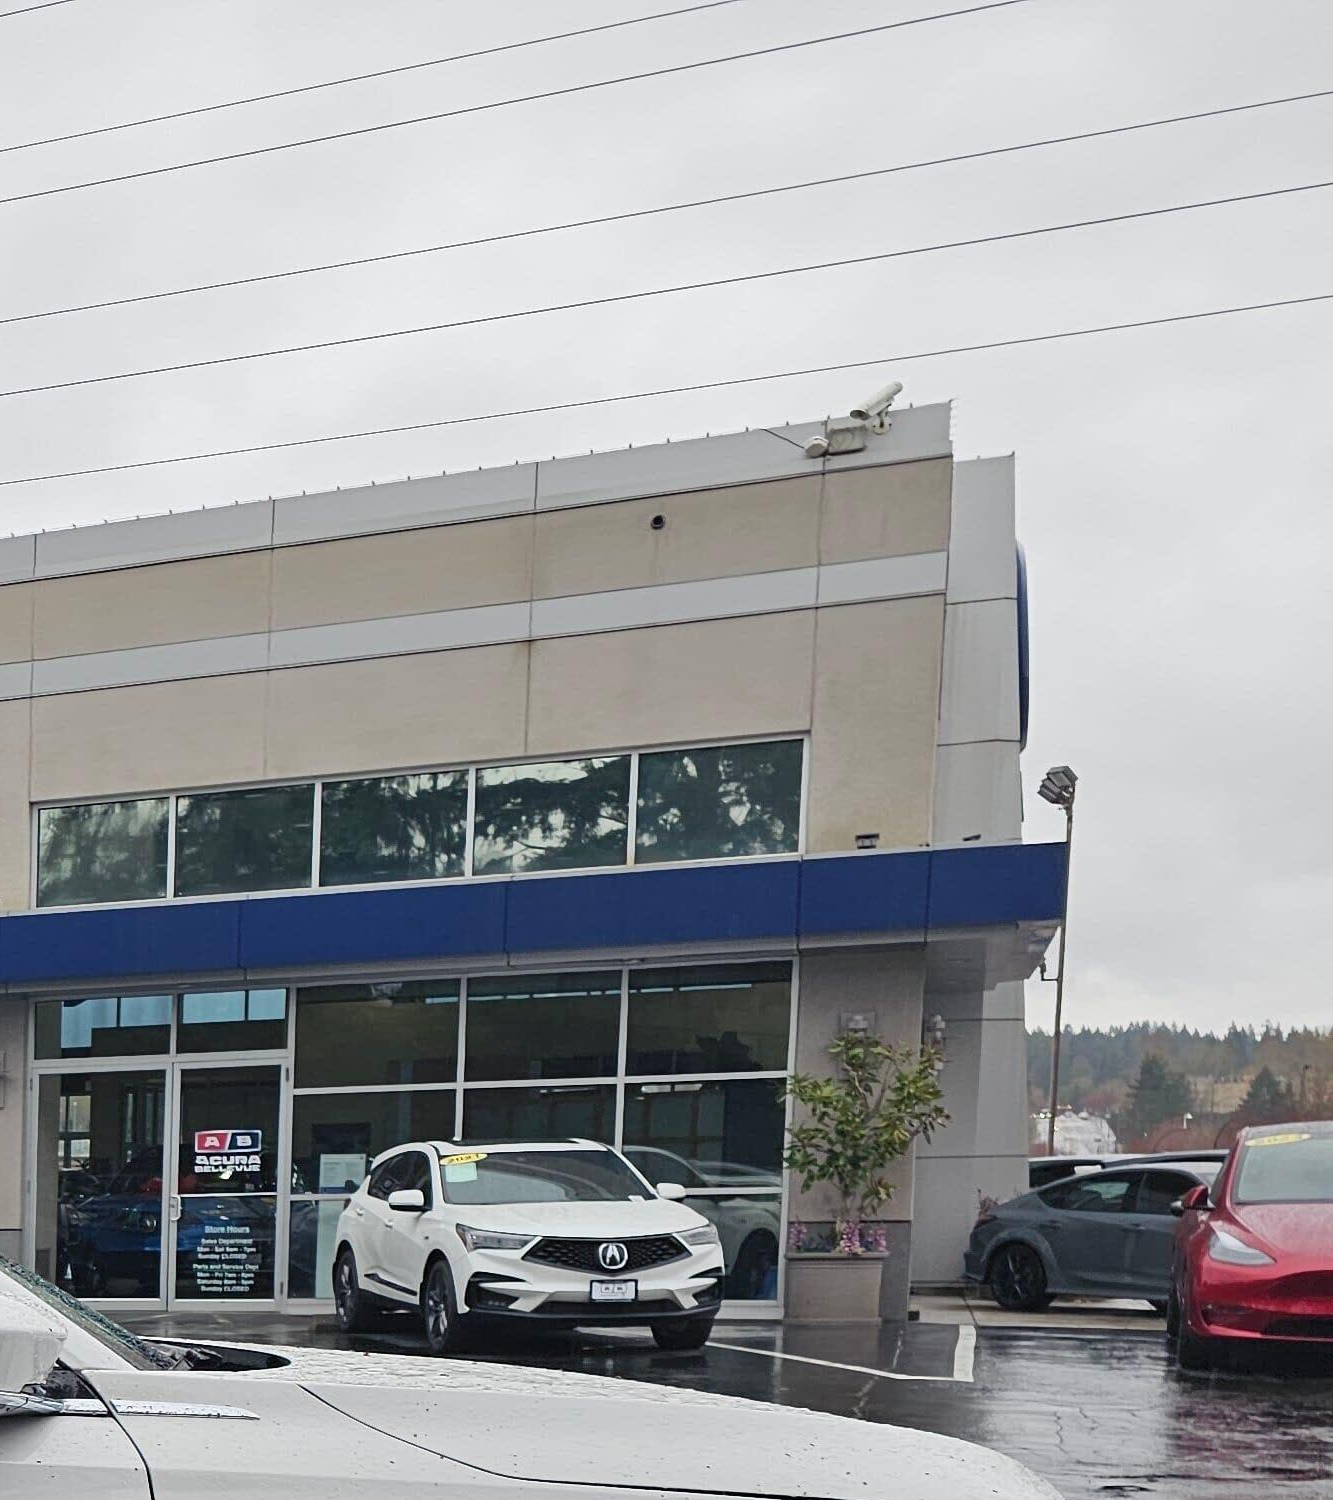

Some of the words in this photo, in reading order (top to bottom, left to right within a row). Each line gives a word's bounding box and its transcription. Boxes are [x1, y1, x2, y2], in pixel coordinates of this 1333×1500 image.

[204, 1136, 220, 1147] A
[236, 1135, 252, 1146] B
[195, 1155, 261, 1165] ACURA
[194, 1165, 261, 1173] BELLEVUE
